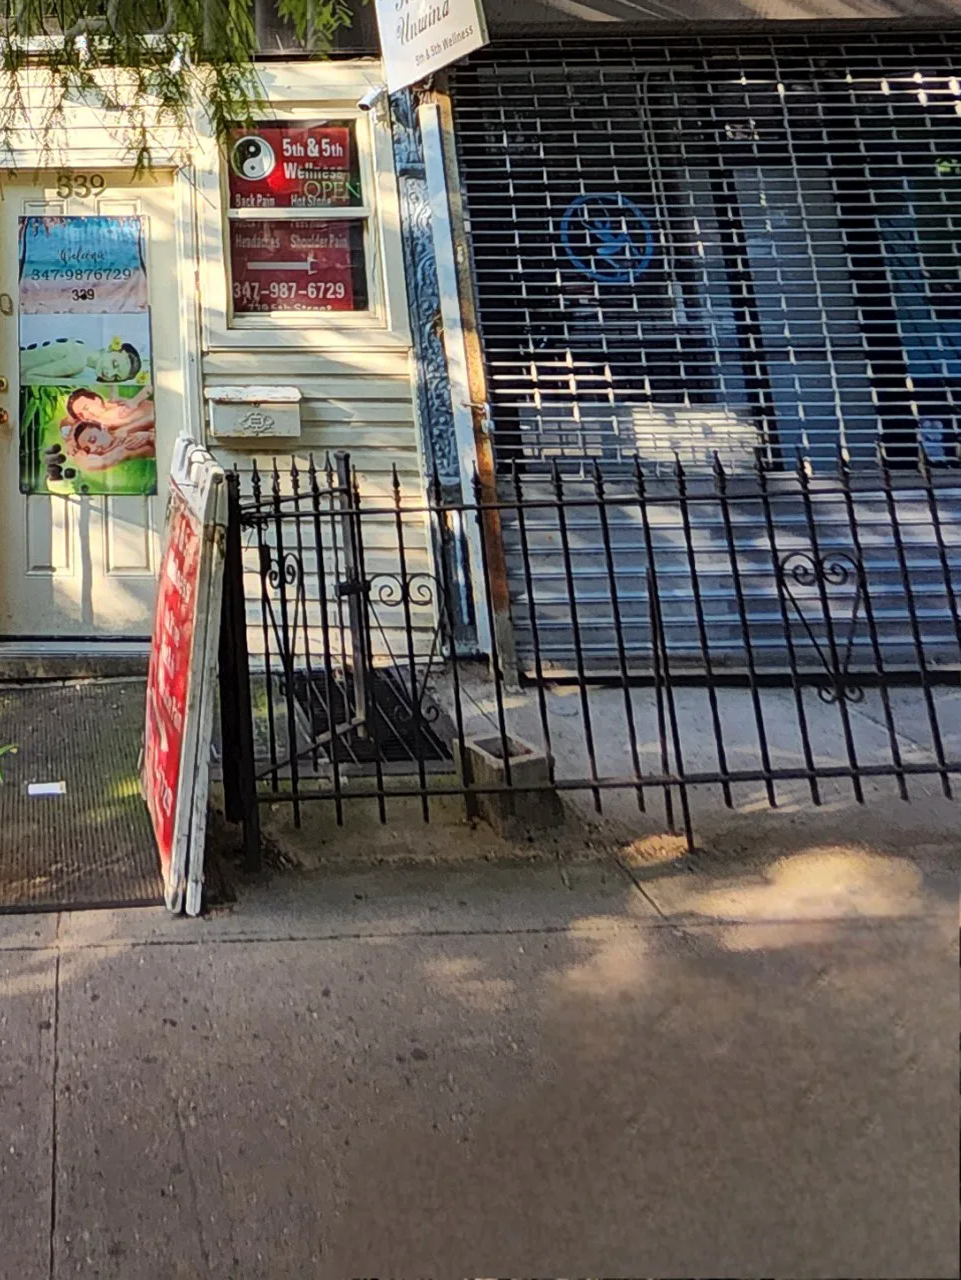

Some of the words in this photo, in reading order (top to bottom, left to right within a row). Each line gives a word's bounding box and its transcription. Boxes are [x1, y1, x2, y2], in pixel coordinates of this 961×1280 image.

[442, 24, 474, 51] Wellness
[282, 138, 305, 157] 5th
[307, 138, 319, 157] &
[321, 138, 343, 157] 5th
[235, 193, 255, 207] Back
[256, 193, 275, 207] Pain
[233, 282, 345, 299] 347-987-6729
